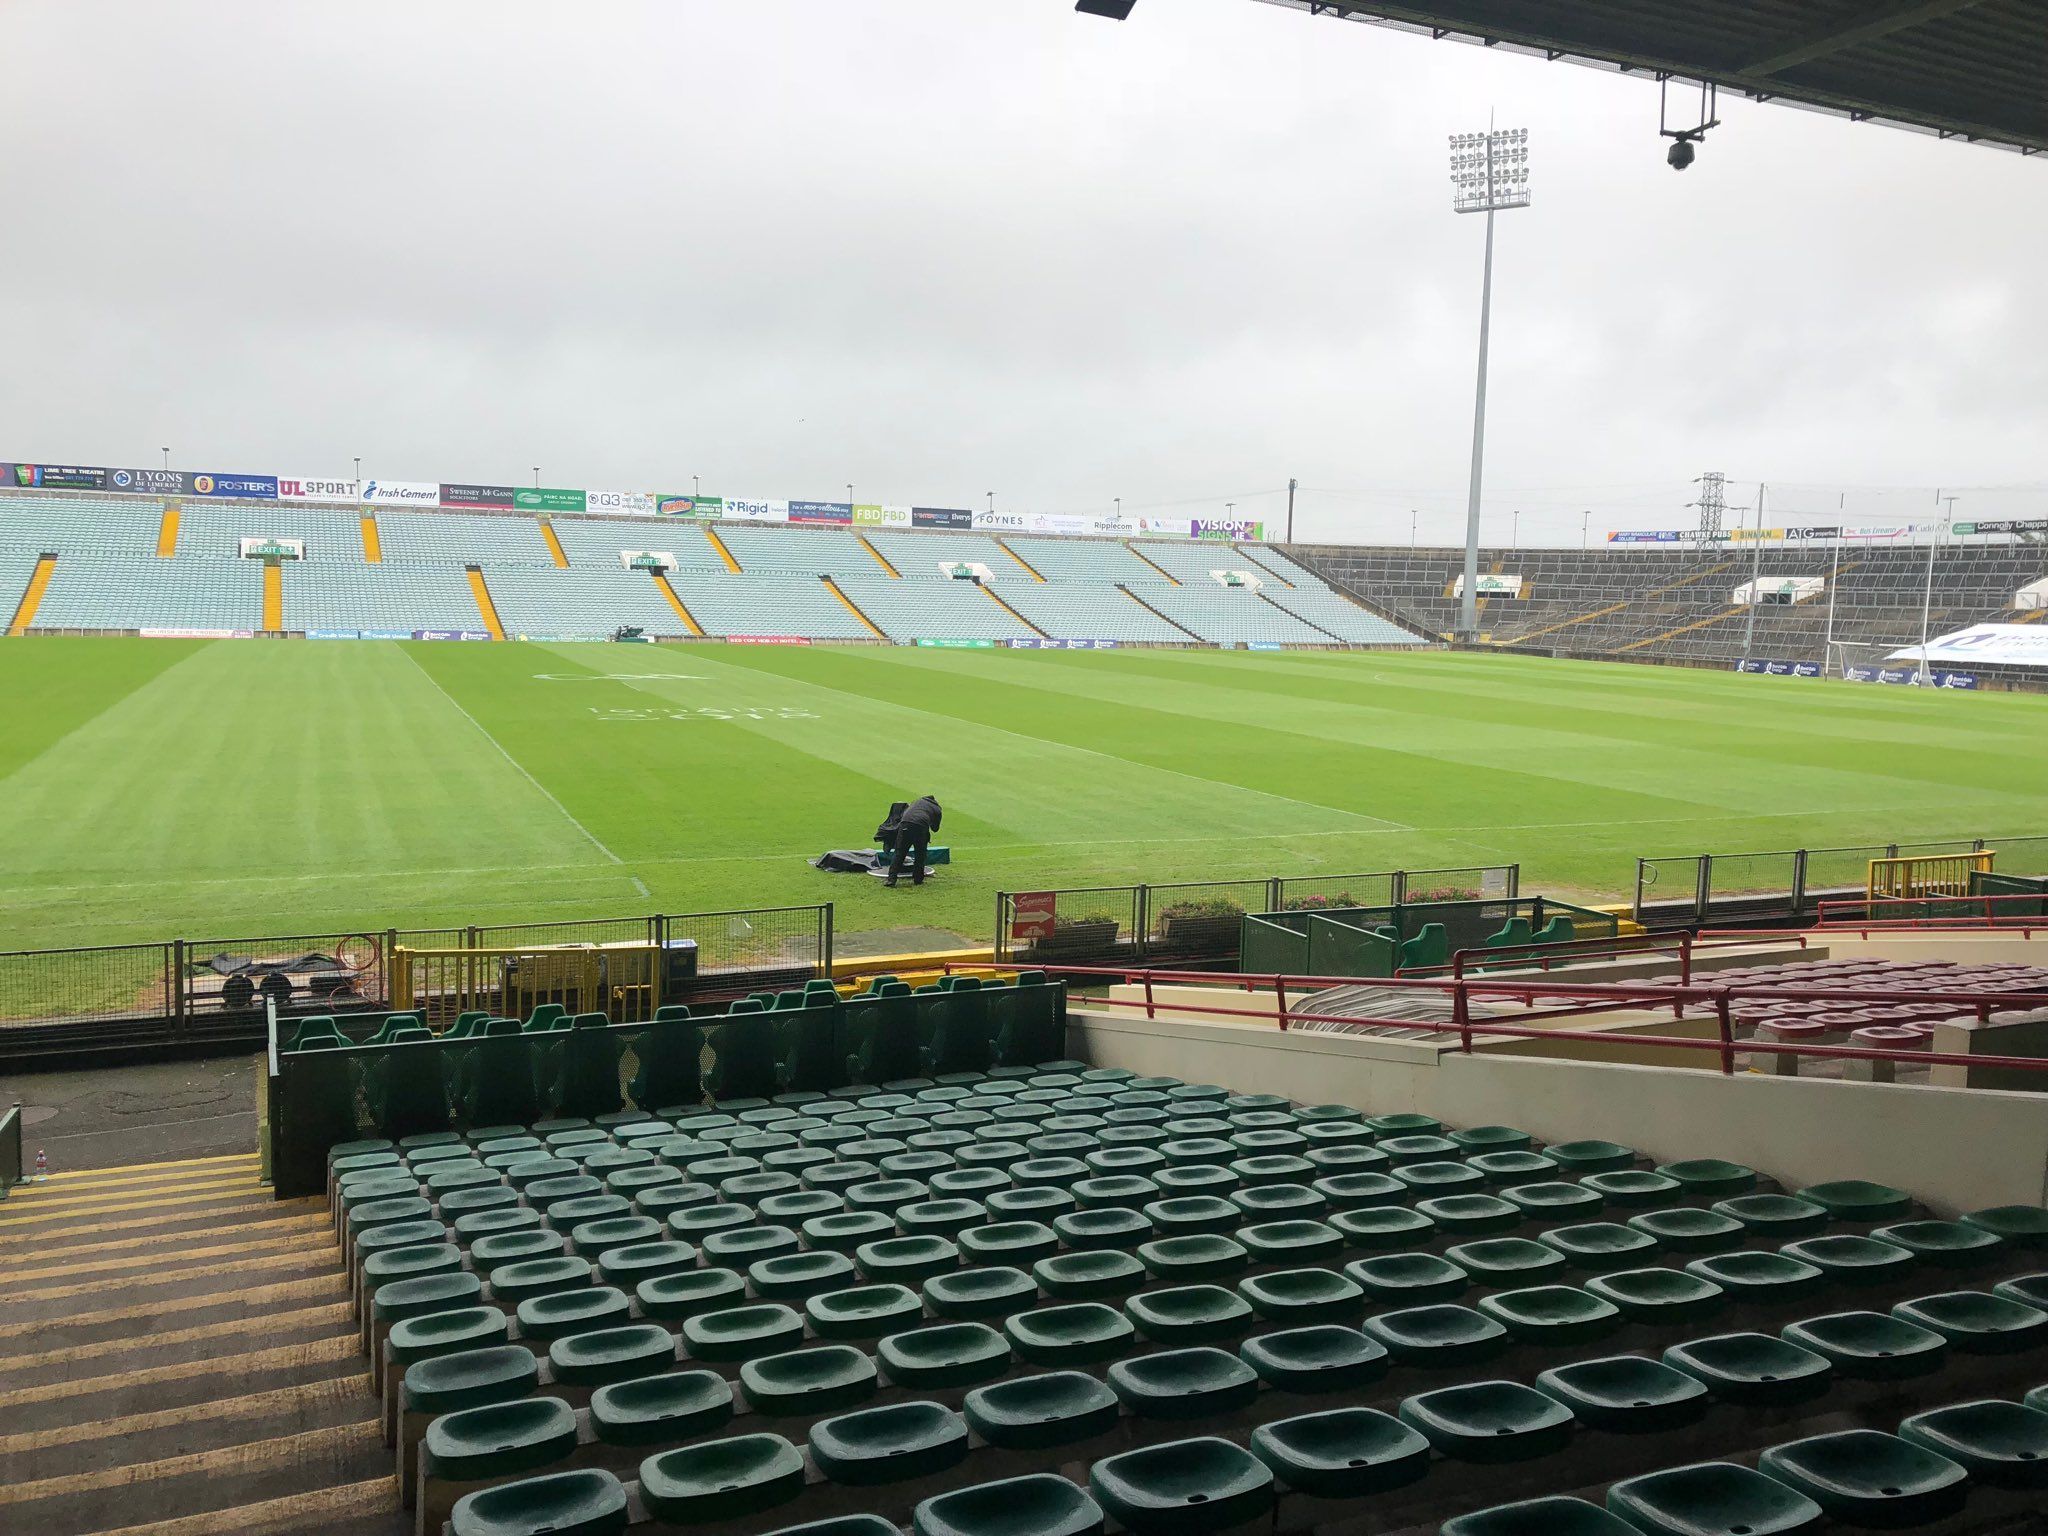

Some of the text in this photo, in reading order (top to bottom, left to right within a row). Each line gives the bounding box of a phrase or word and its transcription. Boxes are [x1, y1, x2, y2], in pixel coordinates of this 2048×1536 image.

[136, 471, 183, 483] LYONS
[218, 480, 275, 492] FOSTER'S
[279, 480, 356, 496] UL SPORT
[377, 487, 437, 500] Irish Cement
[600, 493, 620, 505] Q3
[737, 501, 768, 515] Rigid
[856, 509, 880, 520] FBD
[883, 510, 906, 521] FBD
[951, 513, 971, 521] Elverys
[980, 515, 1023, 525] FOYNES
[1094, 521, 1133, 531] Ripplecom
[1197, 520, 1245, 531] VISION
[1859, 527, 1870, 535] Bus
[1977, 521, 2014, 531] Connolly
[1197, 530, 1245, 540] SIGNS.IE
[1679, 530, 1732, 539] CHAWKE PUBS
[1788, 528, 1815, 539] ATG
